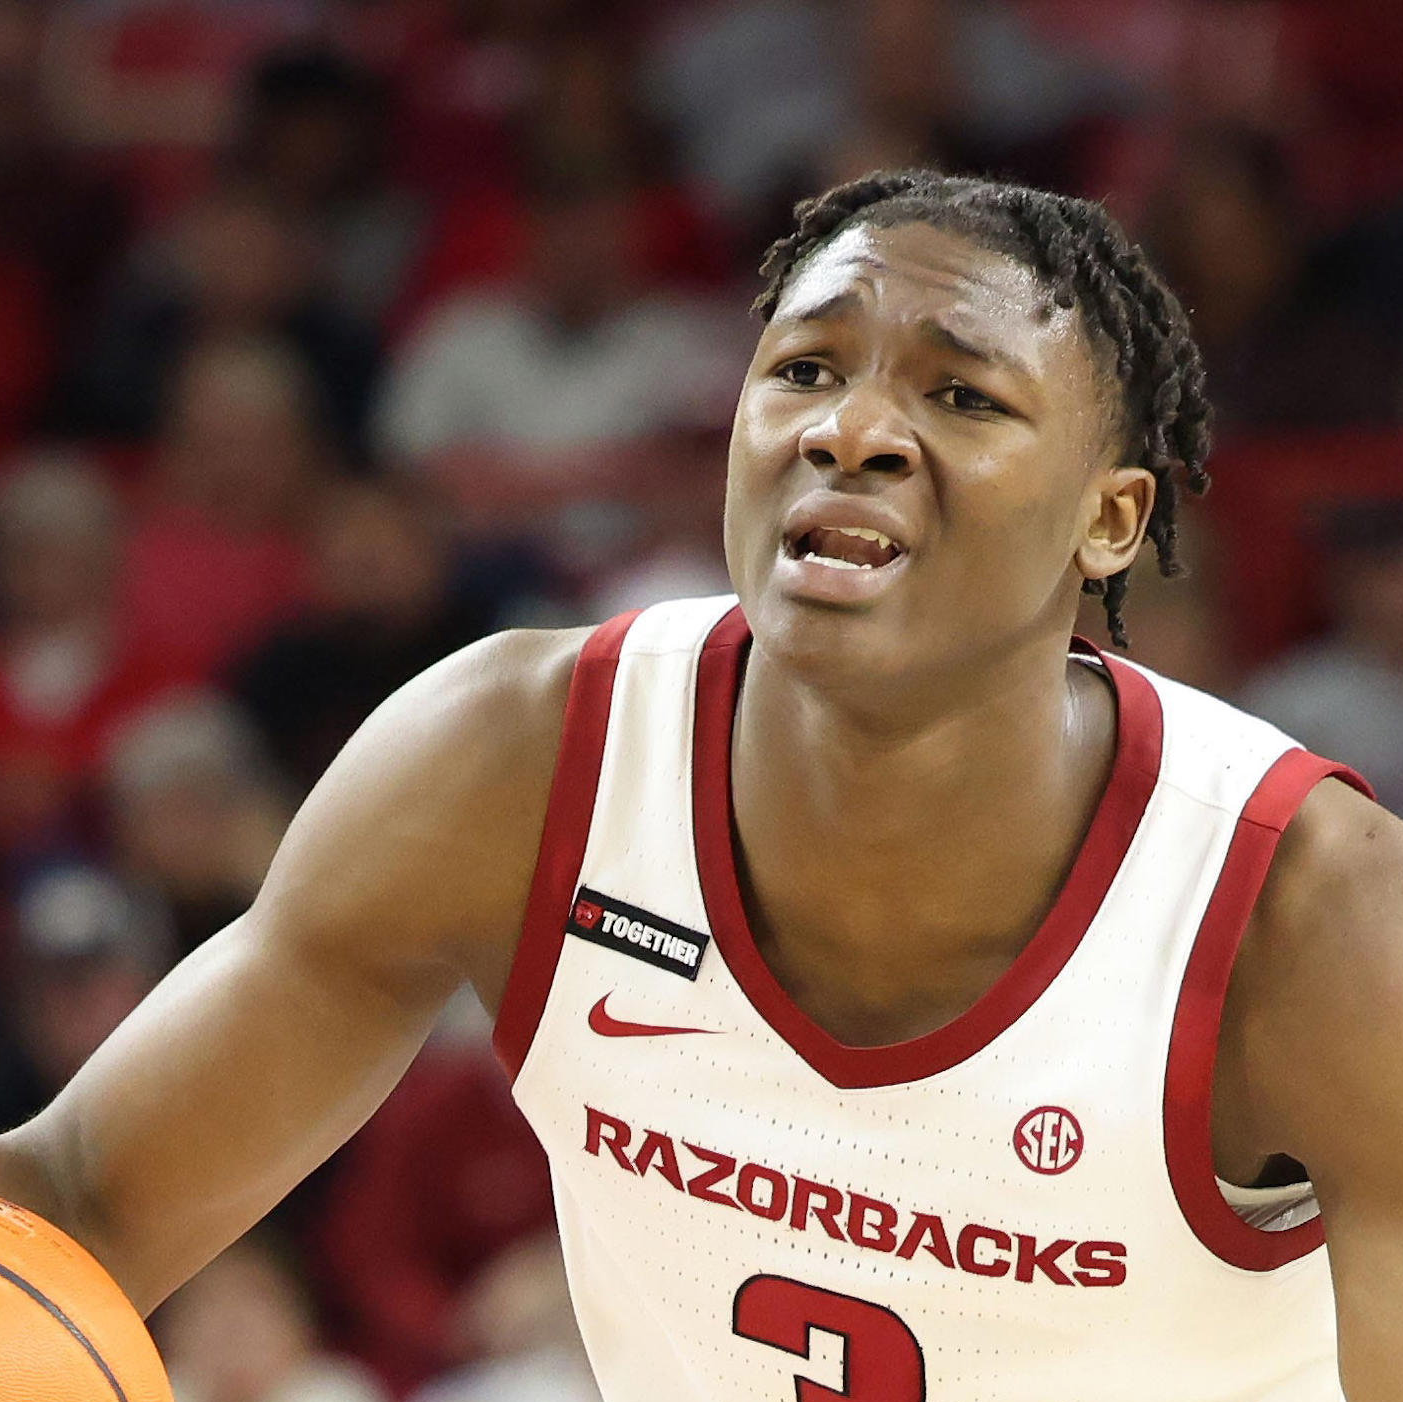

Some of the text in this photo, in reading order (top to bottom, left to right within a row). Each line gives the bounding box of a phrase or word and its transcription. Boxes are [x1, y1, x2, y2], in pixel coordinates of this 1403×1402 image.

[601, 910, 699, 967] TOGETHER
[1020, 1111, 1079, 1169] SEC
[583, 1104, 1128, 1288] RAZORBACKS
